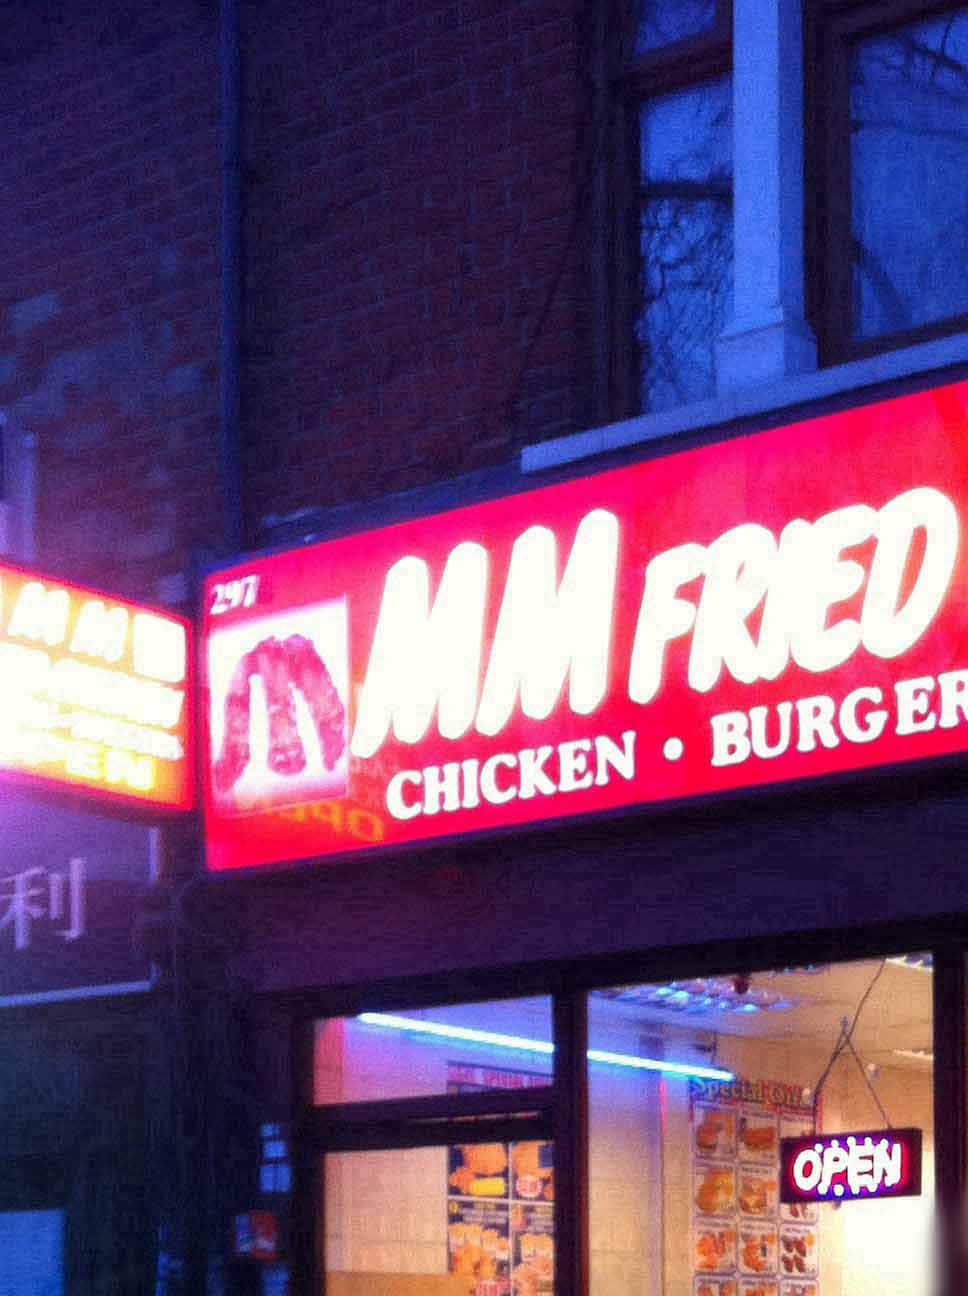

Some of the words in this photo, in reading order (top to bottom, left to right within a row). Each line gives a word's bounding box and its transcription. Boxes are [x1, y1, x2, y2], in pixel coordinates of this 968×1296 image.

[210, 575, 259, 615] 297
[351, 508, 620, 759] MM
[628, 487, 961, 705] FRIED
[386, 730, 637, 820] CHICKEN
[792, 1137, 901, 1196] OPEN
